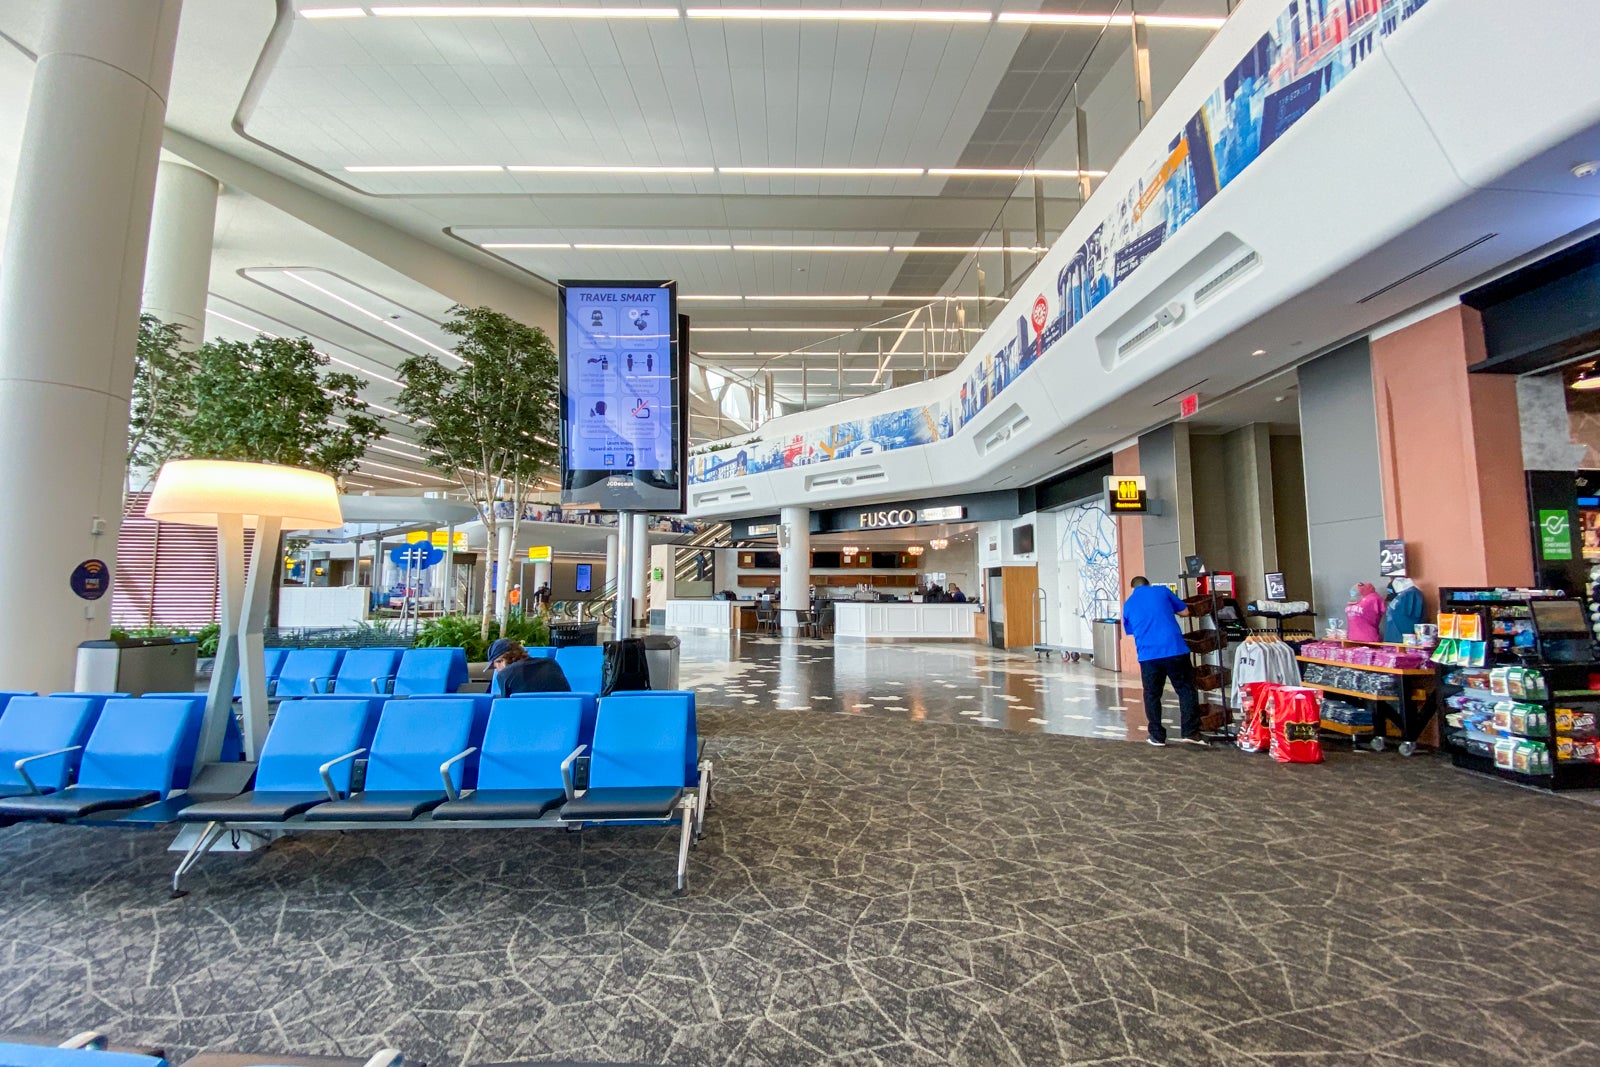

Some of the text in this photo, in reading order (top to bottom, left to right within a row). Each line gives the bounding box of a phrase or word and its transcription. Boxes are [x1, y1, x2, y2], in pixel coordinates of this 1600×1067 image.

[580, 293, 656, 302] TRAVEL SMART
[860, 509, 913, 527] FUSCO
[1381, 549, 1392, 567] 2
